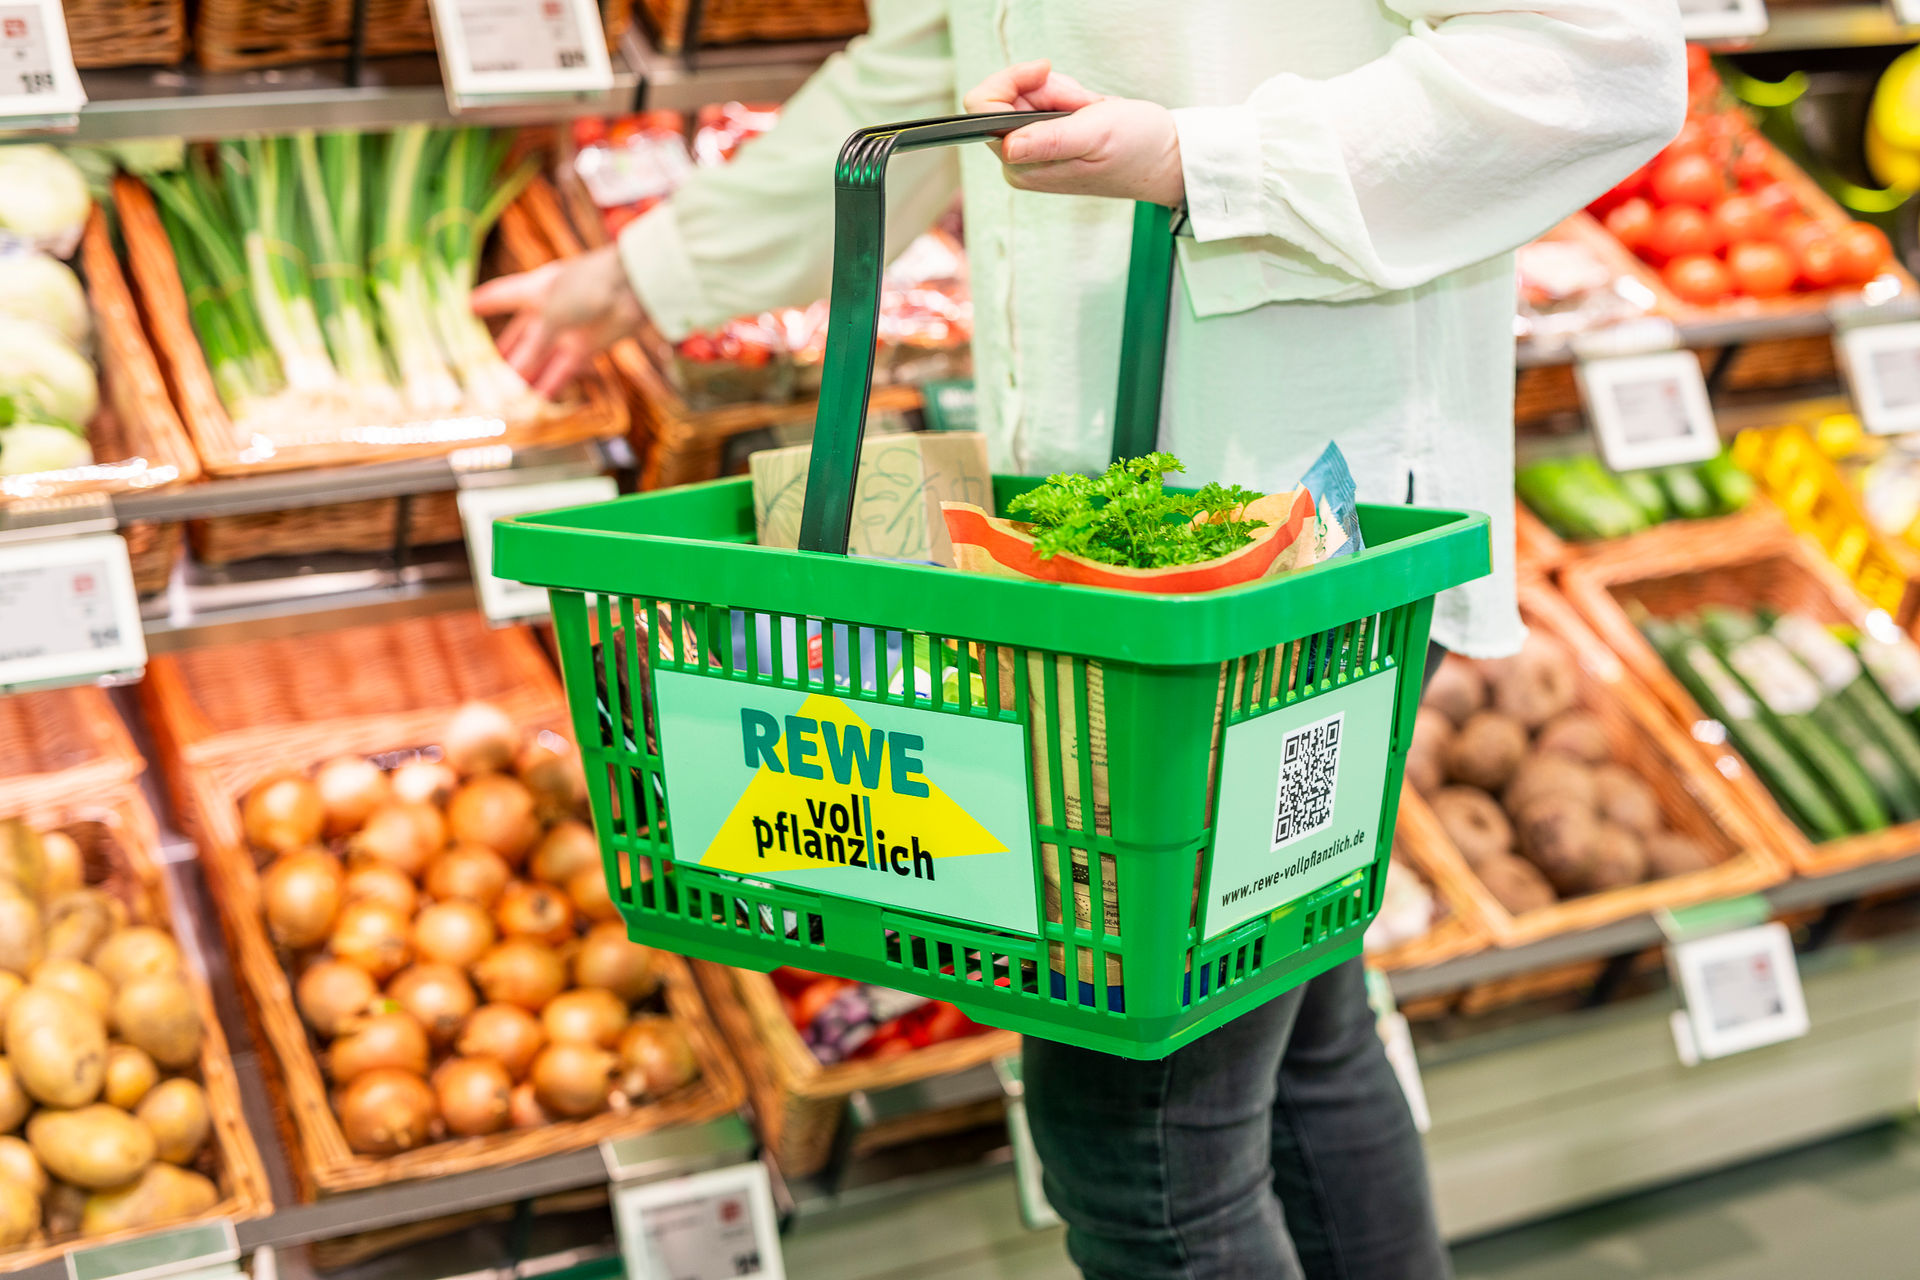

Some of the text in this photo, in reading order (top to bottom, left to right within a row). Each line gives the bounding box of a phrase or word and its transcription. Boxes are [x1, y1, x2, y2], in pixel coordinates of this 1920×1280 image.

[740, 707, 930, 799] REWE
[752, 806, 936, 882] pflanzlich
[1221, 829, 1366, 907] www.rewe-vollpflanzlich.de
